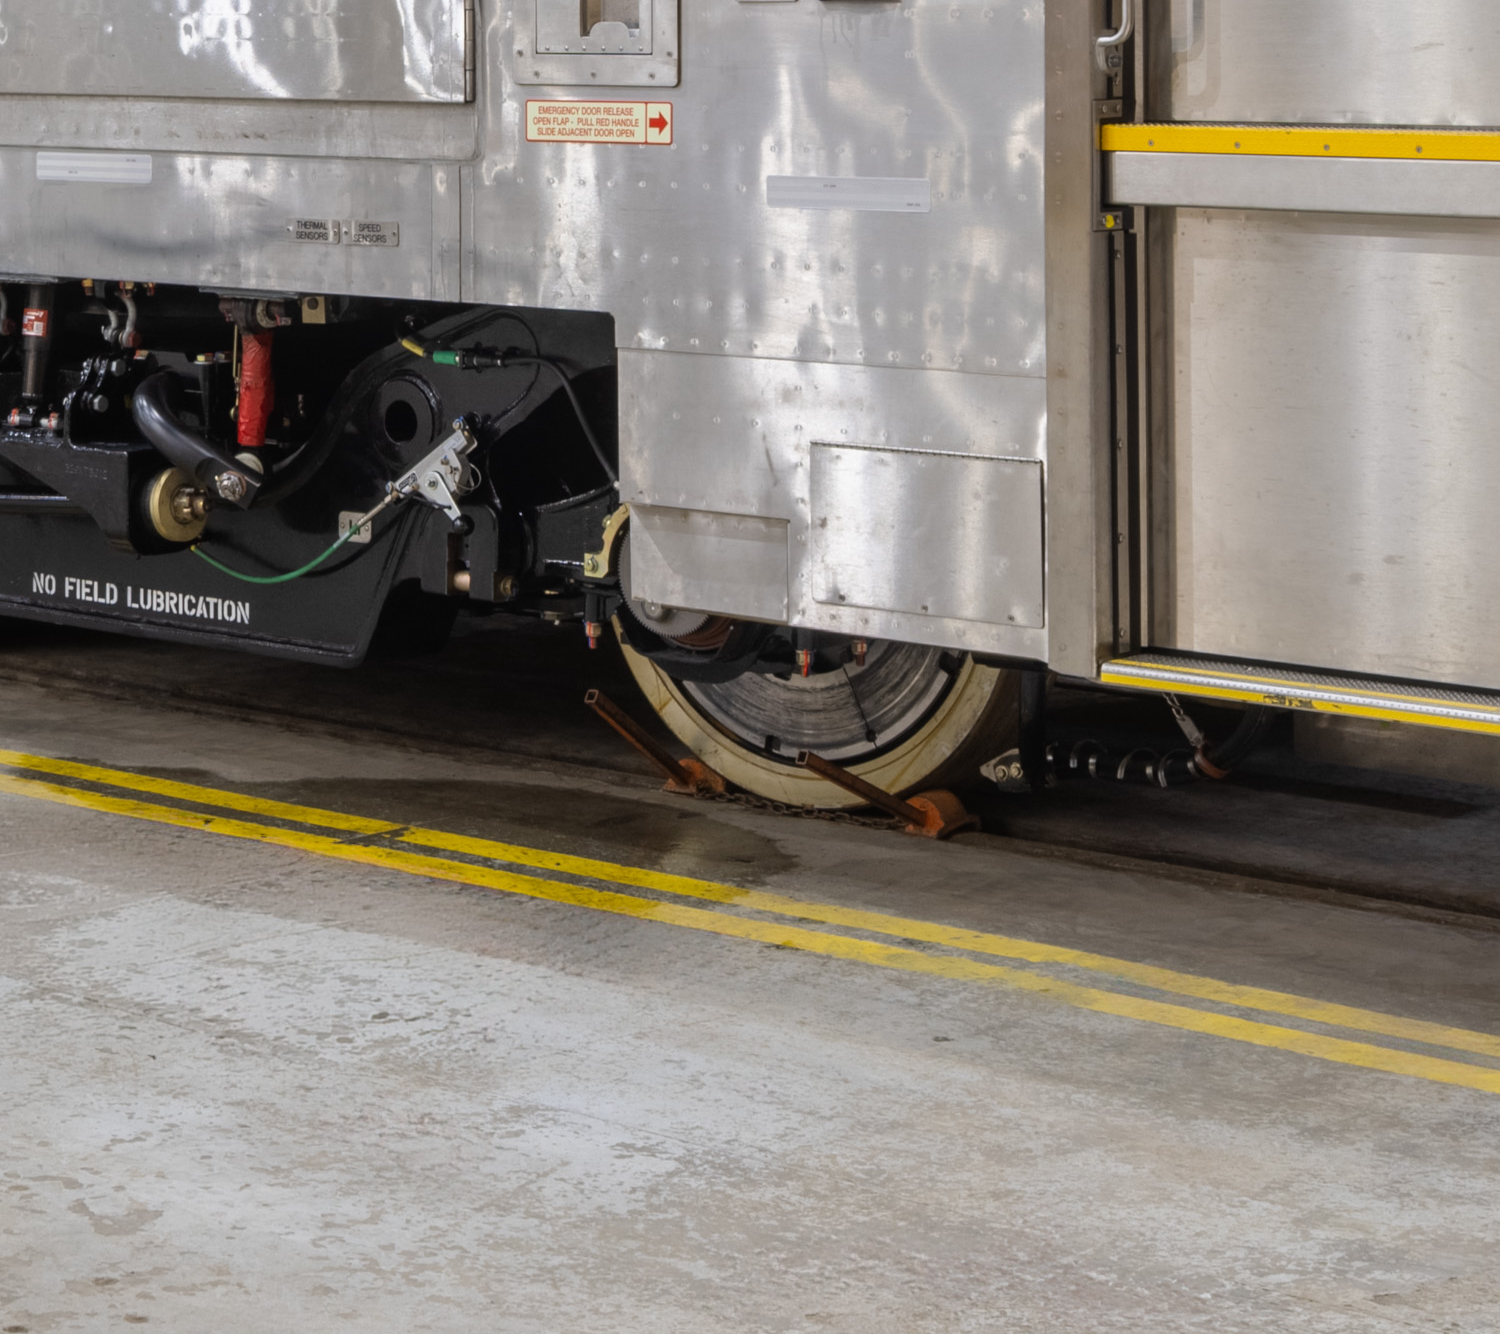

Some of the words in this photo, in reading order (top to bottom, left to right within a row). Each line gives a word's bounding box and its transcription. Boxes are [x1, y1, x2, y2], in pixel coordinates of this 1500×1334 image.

[538, 106, 580, 115] EMERGENCY
[581, 106, 602, 115] DOOR
[603, 107, 634, 116] RELEASE
[532, 117, 552, 125] OPEN
[552, 117, 570, 126] FLAP
[577, 117, 594, 126] PULL
[596, 118, 610, 126] RED
[611, 118, 640, 128] HANDLE
[536, 128, 555, 136] SLIDE
[557, 128, 592, 137] ADJACENT
[594, 128, 614, 137] DOOR
[616, 129, 635, 138] OPEN
[296, 220, 328, 230] THERMAL
[358, 223, 381, 232] SPEED
[296, 231, 329, 240] SENSORS
[353, 234, 387, 243] SENSORS
[32, 571, 56, 596] NO
[64, 576, 118, 606] FIELD
[126, 585, 250, 625] LUBRICATION
